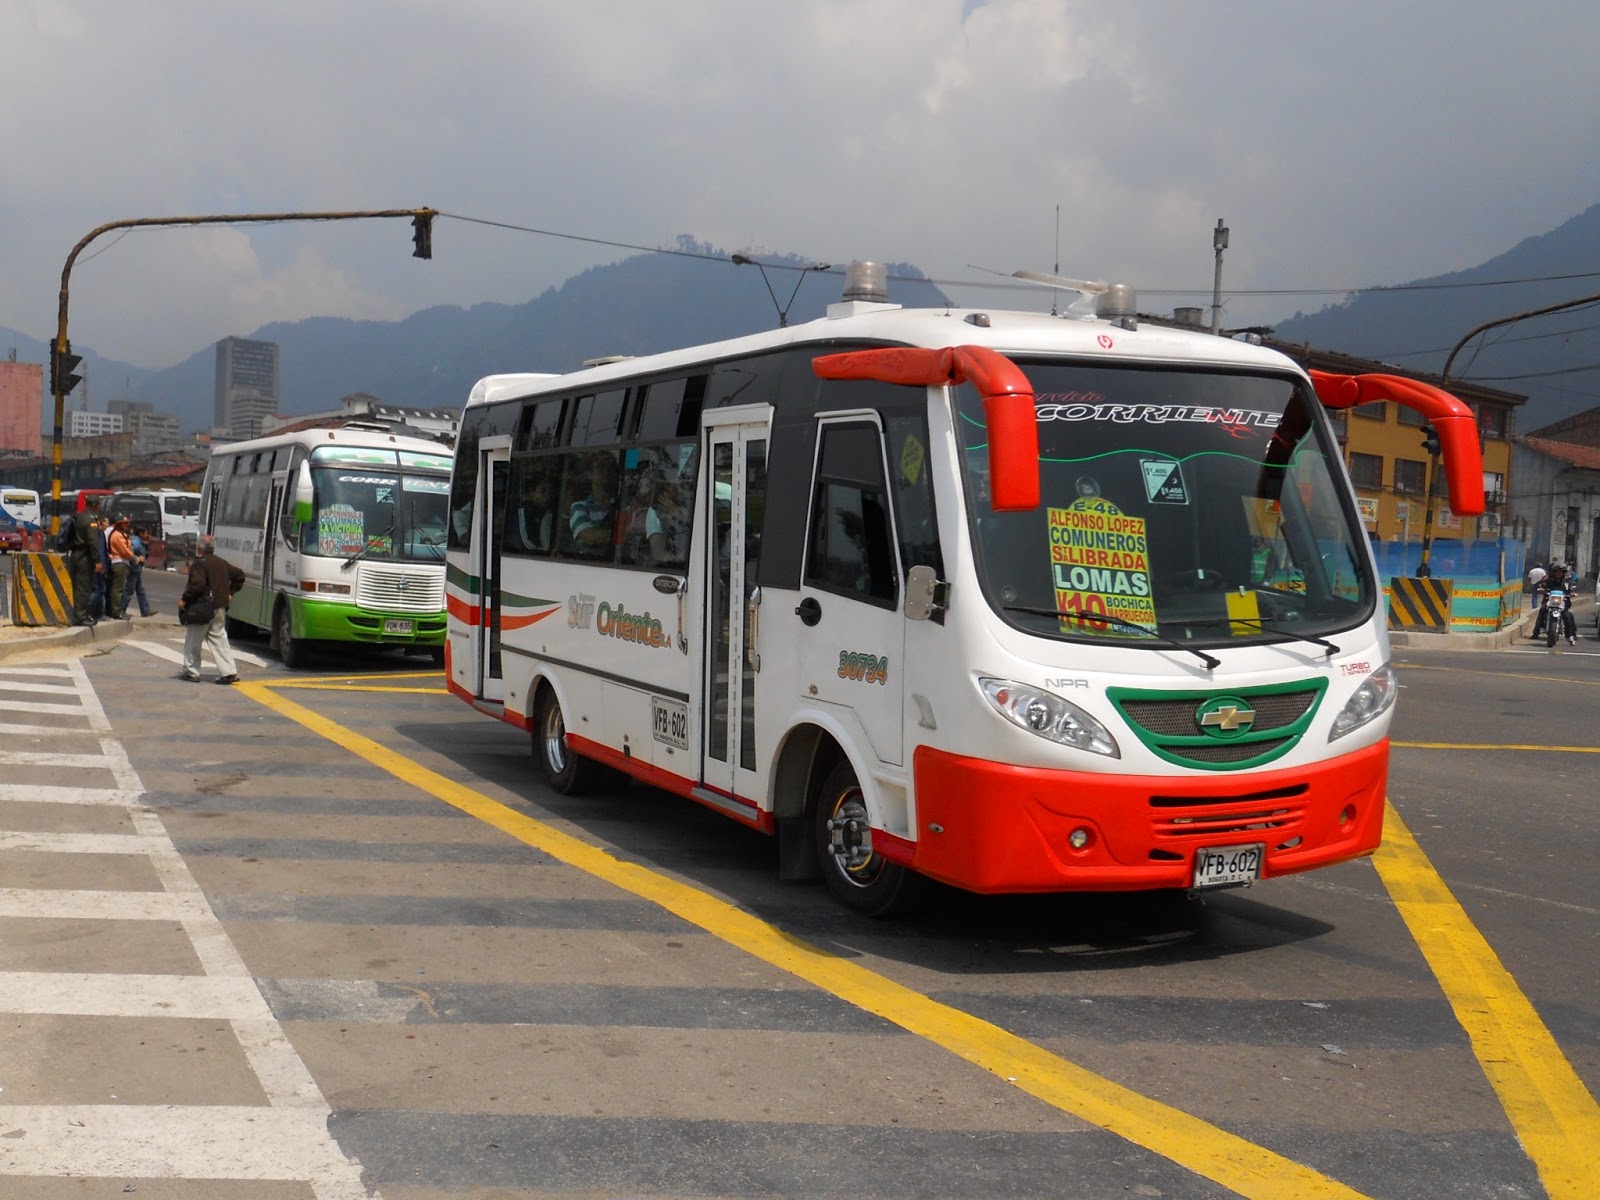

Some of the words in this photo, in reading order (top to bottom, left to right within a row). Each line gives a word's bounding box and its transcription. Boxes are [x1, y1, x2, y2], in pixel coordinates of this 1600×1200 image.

[1033, 403, 1283, 427] CORRIENTE
[320, 516, 362, 526] COLUMNAS
[1074, 502, 1119, 516] E-48
[320, 524, 330, 533] LA
[330, 524, 362, 534] VICTORIA
[1050, 510, 1104, 531] ALFONSO
[1108, 517, 1144, 535] LOPEZ
[1050, 526, 1146, 553] COMUNEROS
[1054, 565, 1149, 596] LOMAS
[1106, 596, 1152, 610] BOCHICA
[597, 601, 662, 648] Oriente
[1107, 608, 1154, 623] MARRUECOS
[838, 650, 888, 685] 30734
[1340, 662, 1371, 671] TURBO
[1045, 678, 1089, 688] NPR
[653, 705, 686, 739] VFB-602
[1199, 850, 1257, 877] VFB-602
